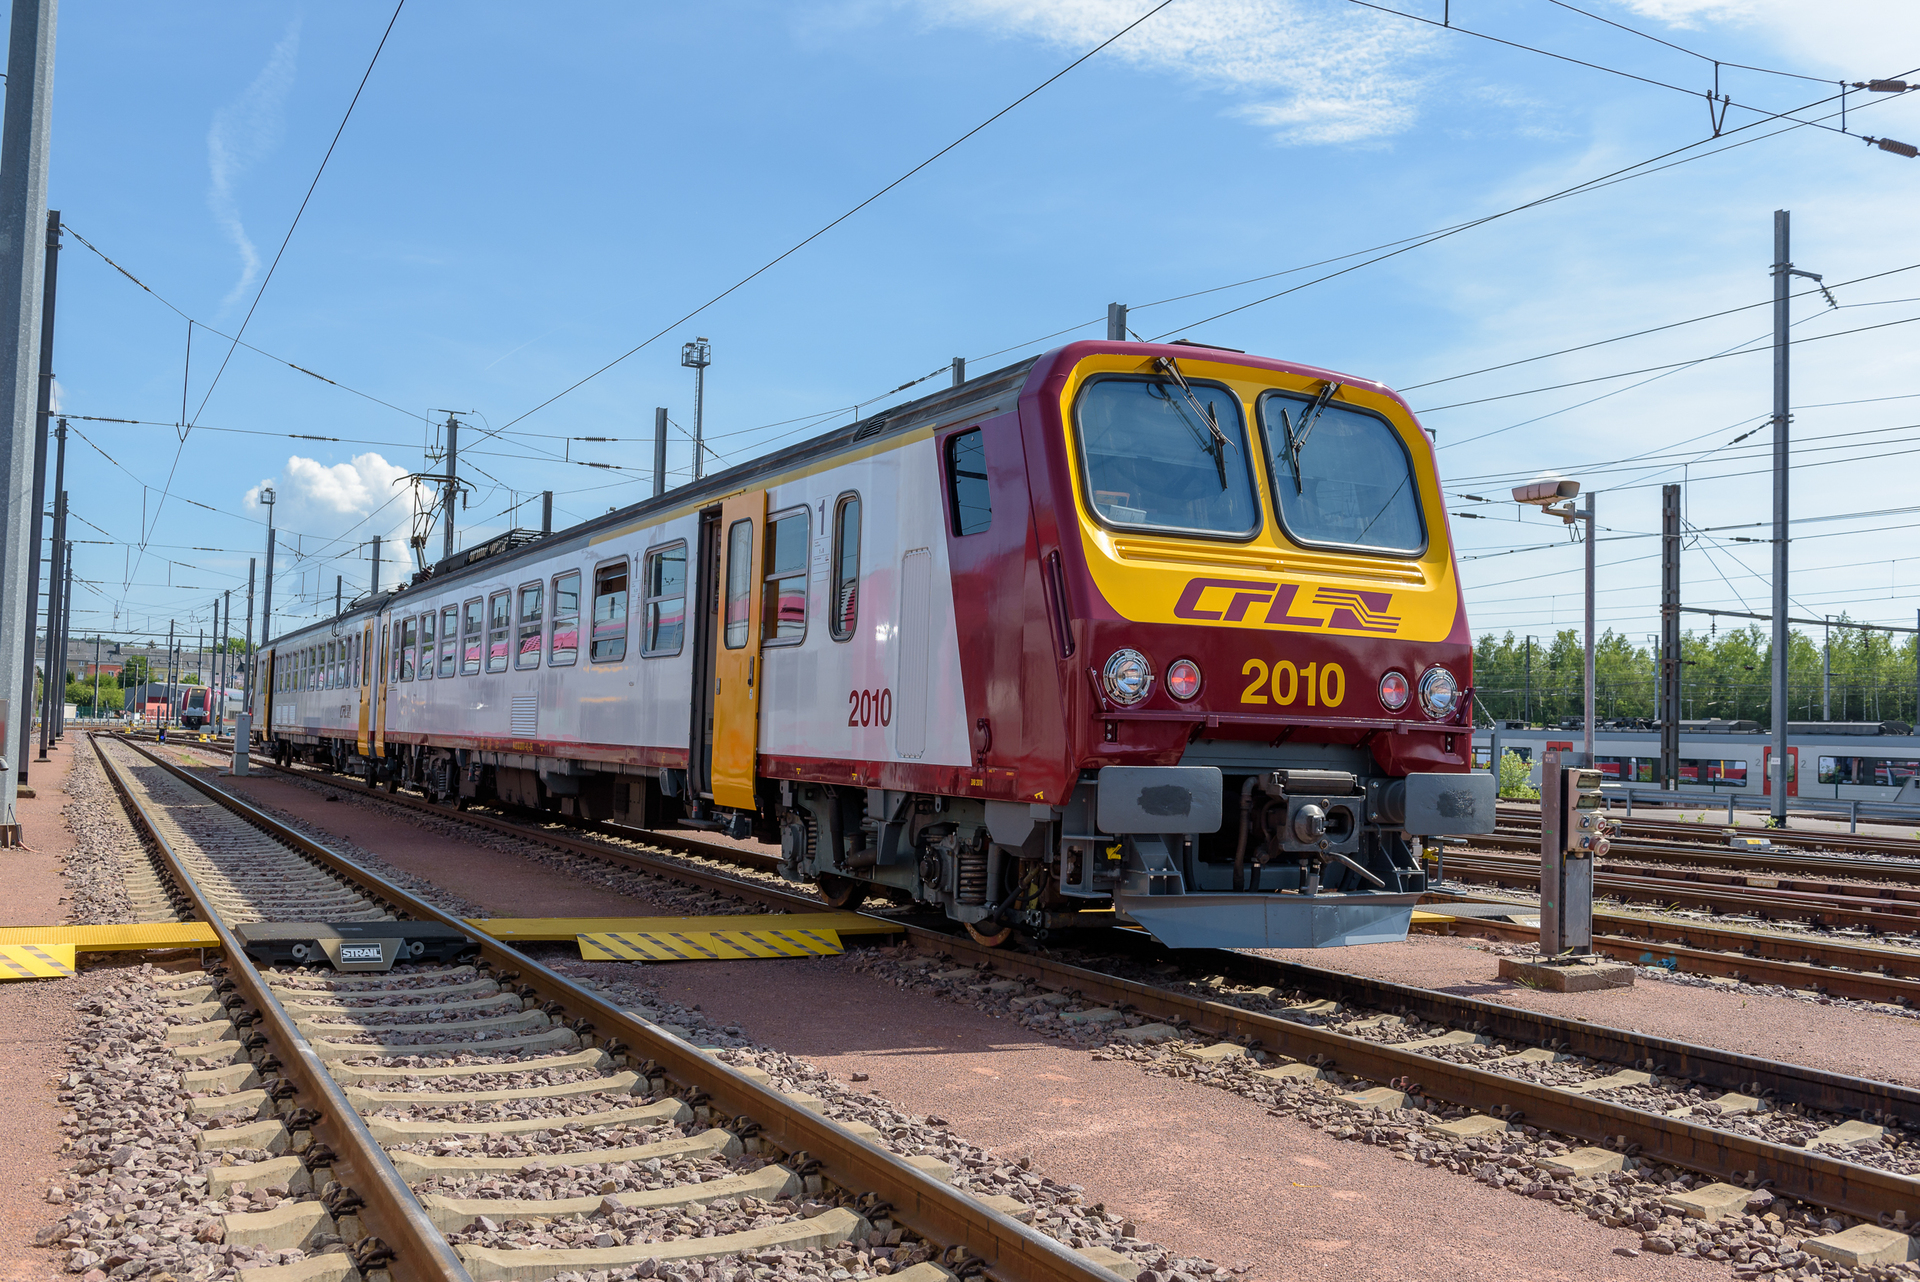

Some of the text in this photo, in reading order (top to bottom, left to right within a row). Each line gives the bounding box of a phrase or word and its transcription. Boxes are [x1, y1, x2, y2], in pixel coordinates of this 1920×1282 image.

[818, 499, 826, 536] 1
[1173, 577, 1325, 628] CFL
[1240, 658, 1346, 708] 2010
[848, 688, 892, 728] 2010
[1755, 758, 1761, 767] 2
[1800, 759, 1807, 768] 2
[342, 948, 381, 958] STRAIL
